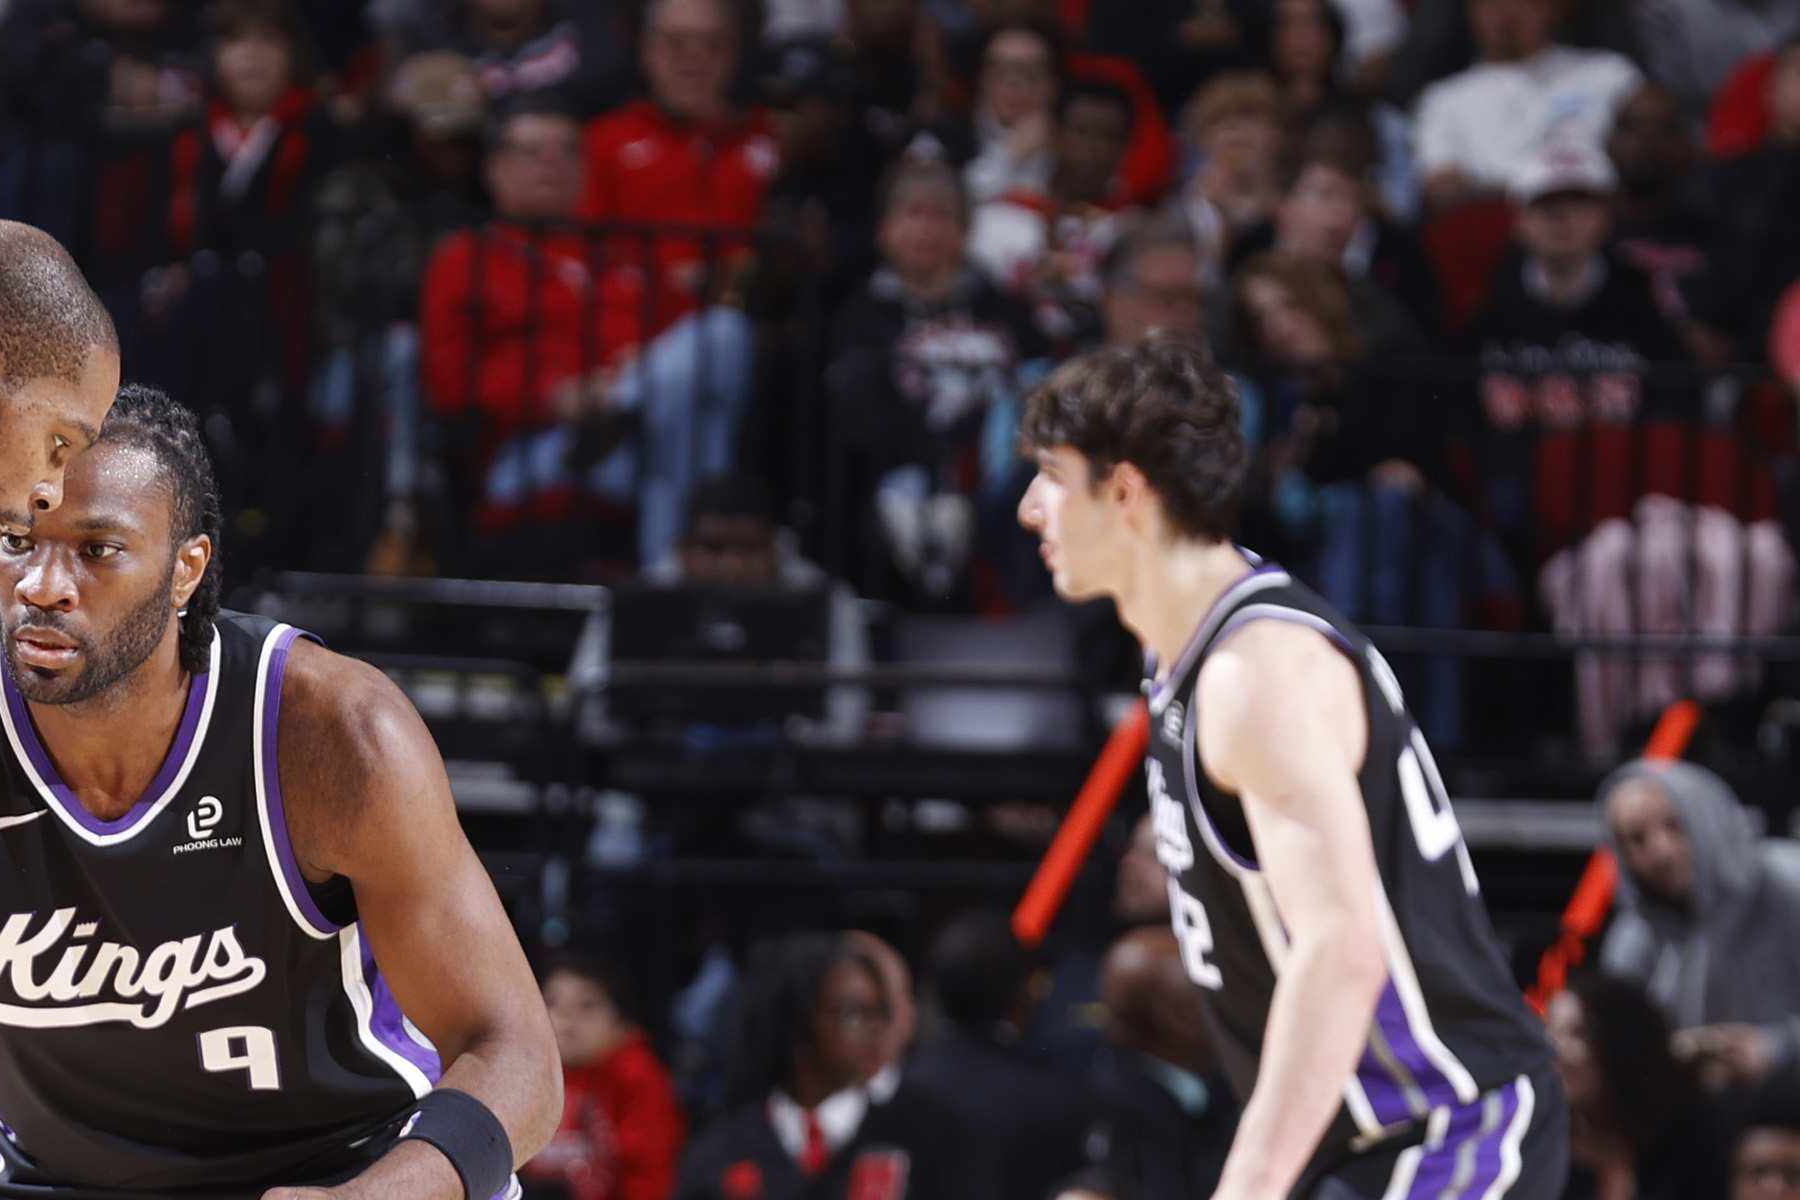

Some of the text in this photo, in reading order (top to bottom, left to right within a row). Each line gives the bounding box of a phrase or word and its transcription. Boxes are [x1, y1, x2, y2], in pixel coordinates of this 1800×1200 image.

[172, 837, 242, 855] PHOONG LAW
[196, 1025, 281, 1090] 9
